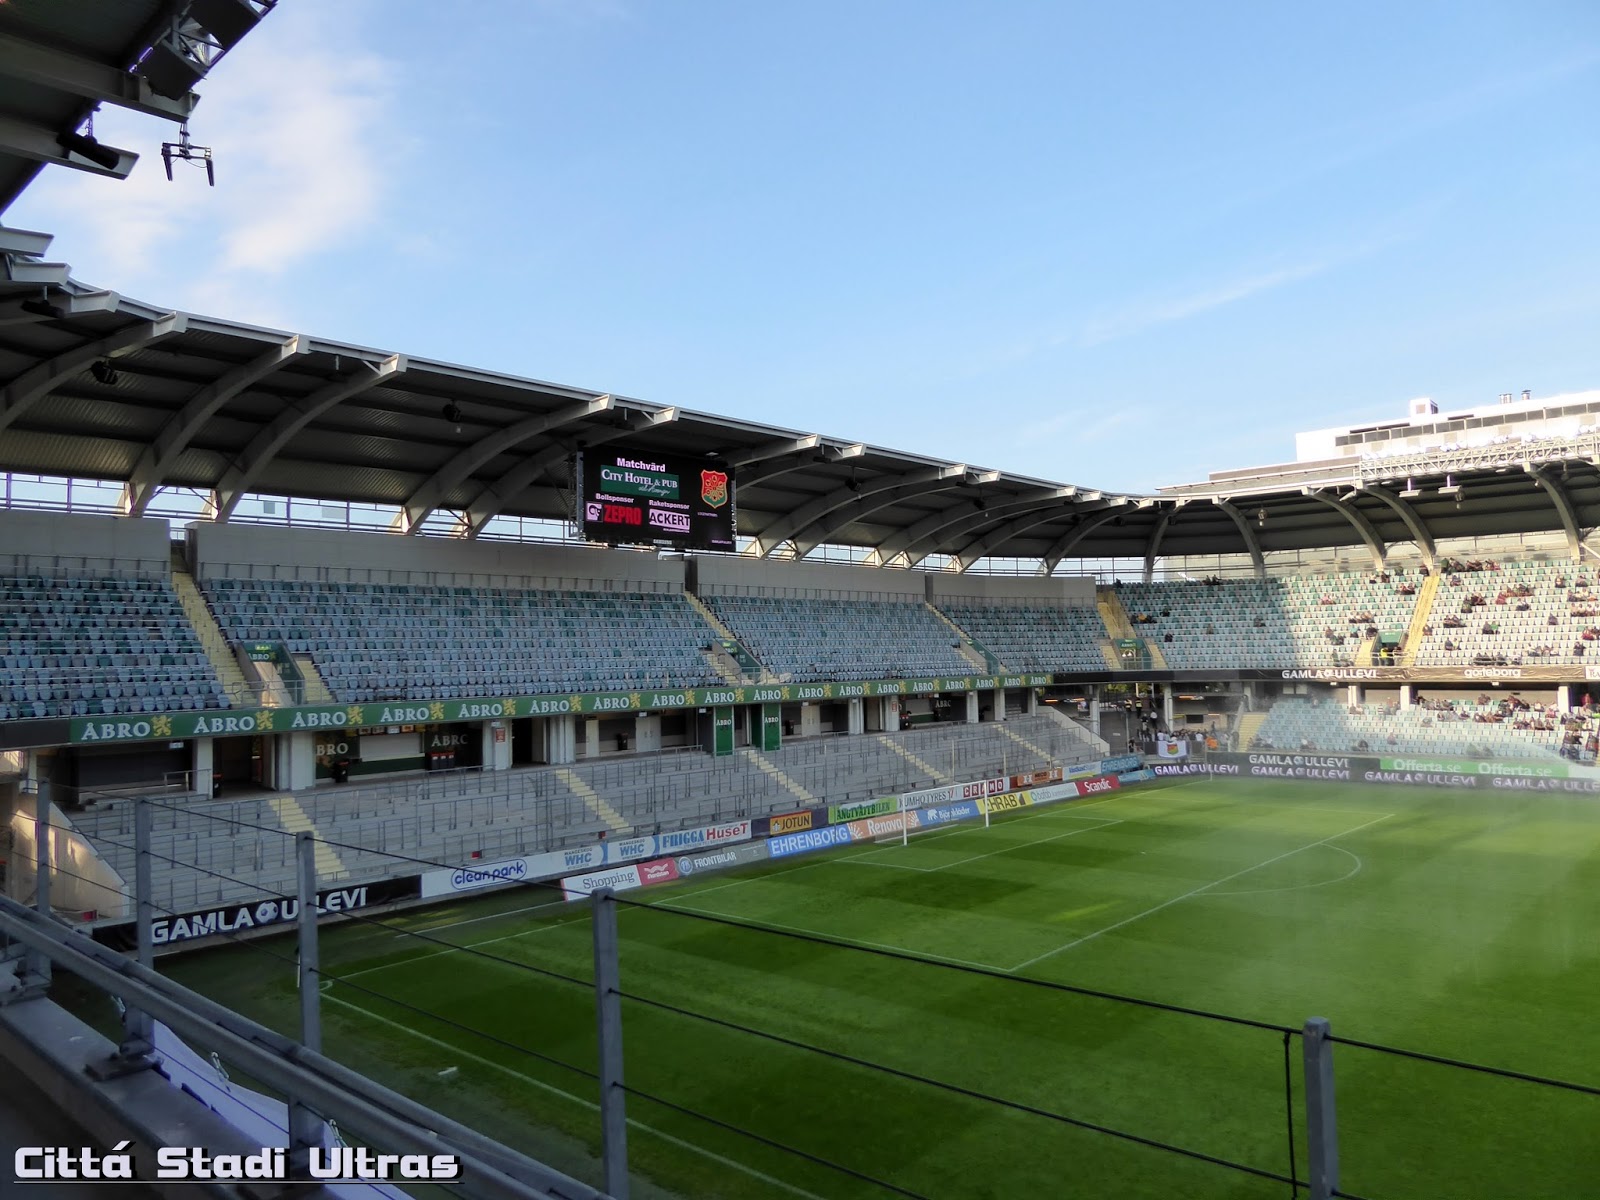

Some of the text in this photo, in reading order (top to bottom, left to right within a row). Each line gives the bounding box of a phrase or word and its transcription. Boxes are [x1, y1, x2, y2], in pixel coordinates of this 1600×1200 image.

[617, 457, 666, 473] Matchvärd
[661, 479, 678, 488] PUB
[604, 504, 642, 526] ZEPRO
[649, 512, 690, 527] ACKERT
[1281, 669, 1377, 679] GAMLA ULLEVI
[458, 703, 503, 719] ÅBRO
[529, 699, 570, 714] ÅBRO
[292, 711, 347, 728] ÅBRO
[380, 707, 429, 722] ÅBRO
[81, 721, 150, 741] ÅBRO
[193, 716, 255, 735] ÅBRO
[316, 743, 349, 757] BRO
[1249, 754, 1349, 768] GAMLA ULLEVI
[1154, 765, 1190, 775] GAMLA
[1198, 763, 1239, 774] ULLEVI
[1251, 766, 1350, 780] GAMLA ULLEVI
[1084, 778, 1112, 793] Scandic
[1364, 771, 1476, 787] GAMLA ULLEVI
[1492, 777, 1600, 792] GAMLA ULLE
[926, 792, 947, 803] TYRES
[781, 814, 810, 830] JOTUN
[867, 818, 903, 835] Renova
[662, 830, 705, 848] FRIGGA
[770, 827, 848, 854] EHRENBORG
[620, 843, 645, 857] WHC
[565, 852, 592, 866] WHC
[694, 852, 737, 868] FRONTBILAR
[582, 872, 635, 889] Shopping
[151, 887, 368, 943] GAMLA ULEVI
